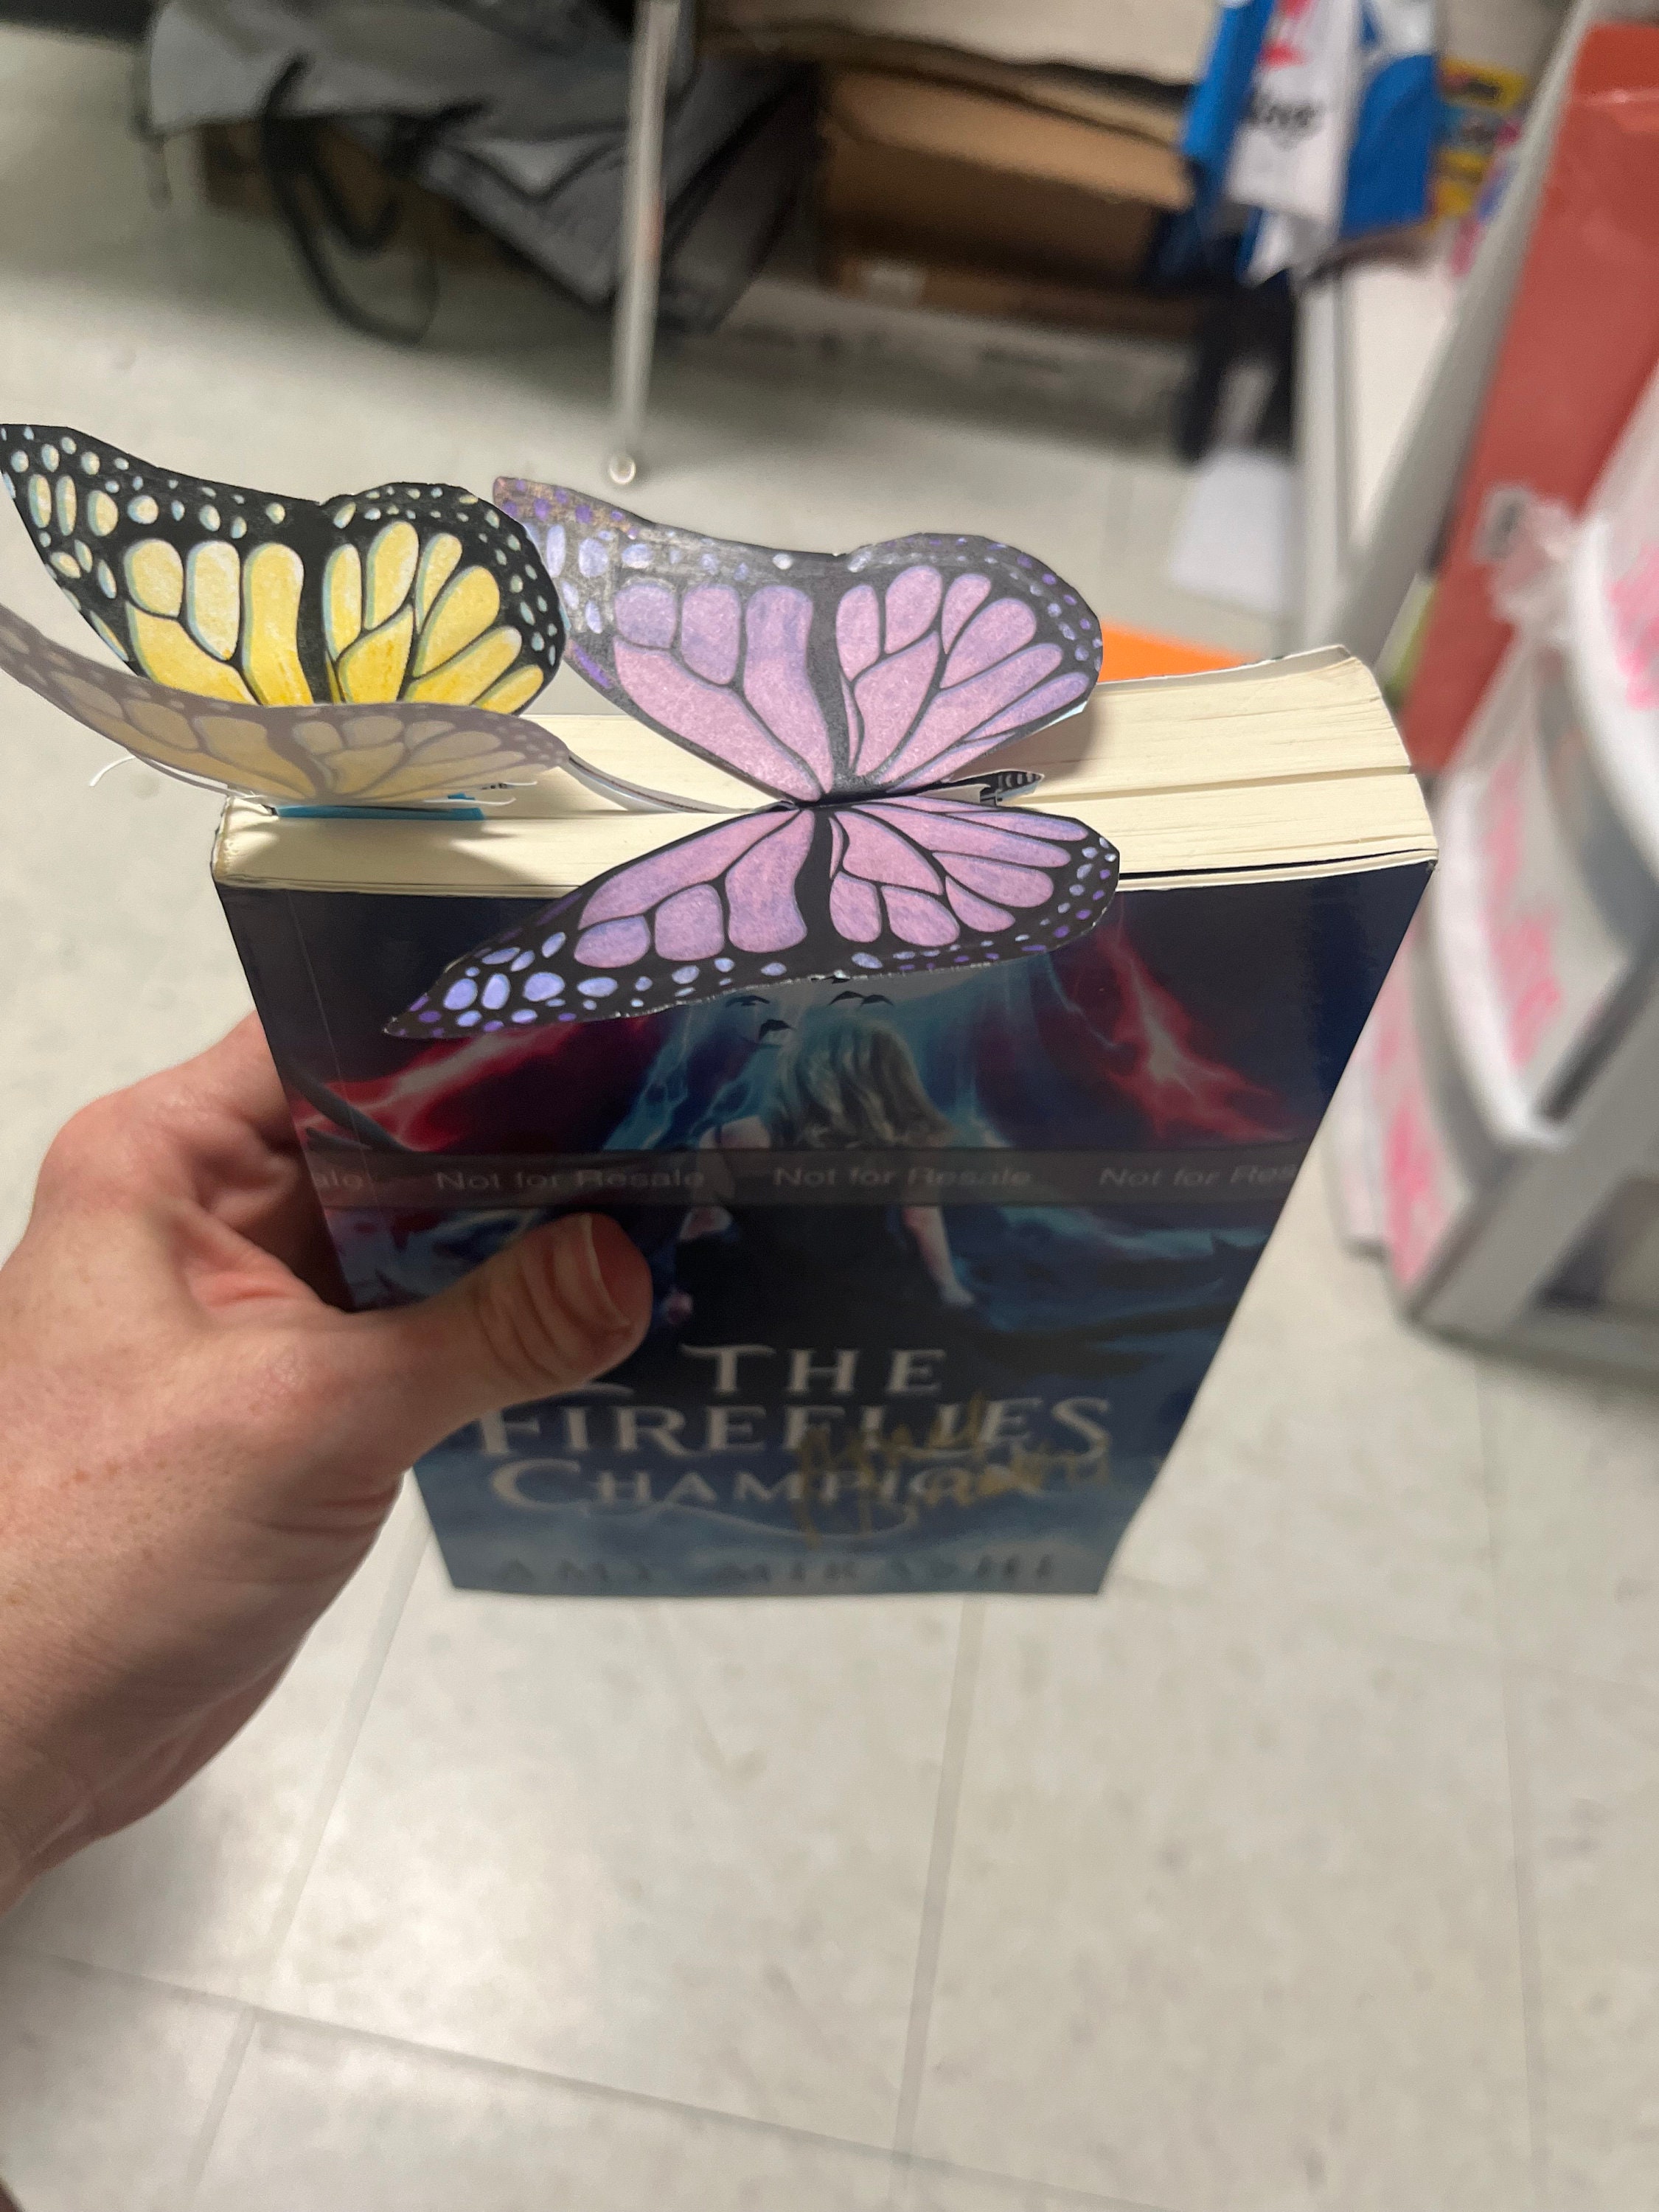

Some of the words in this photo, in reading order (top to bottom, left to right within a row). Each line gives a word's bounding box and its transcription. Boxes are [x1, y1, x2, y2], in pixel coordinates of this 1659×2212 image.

[435, 1170, 501, 1191] Not
[514, 1170, 560, 1189] for
[574, 1167, 705, 1189] Resale
[773, 1166, 837, 1187] Not
[848, 1166, 899, 1186] for
[906, 1166, 1032, 1186] Resale
[1099, 1167, 1163, 1186] Not
[1173, 1166, 1221, 1186] for
[681, 1343, 947, 1396] THE
[476, 1381, 1111, 1460] FIREFLIES
